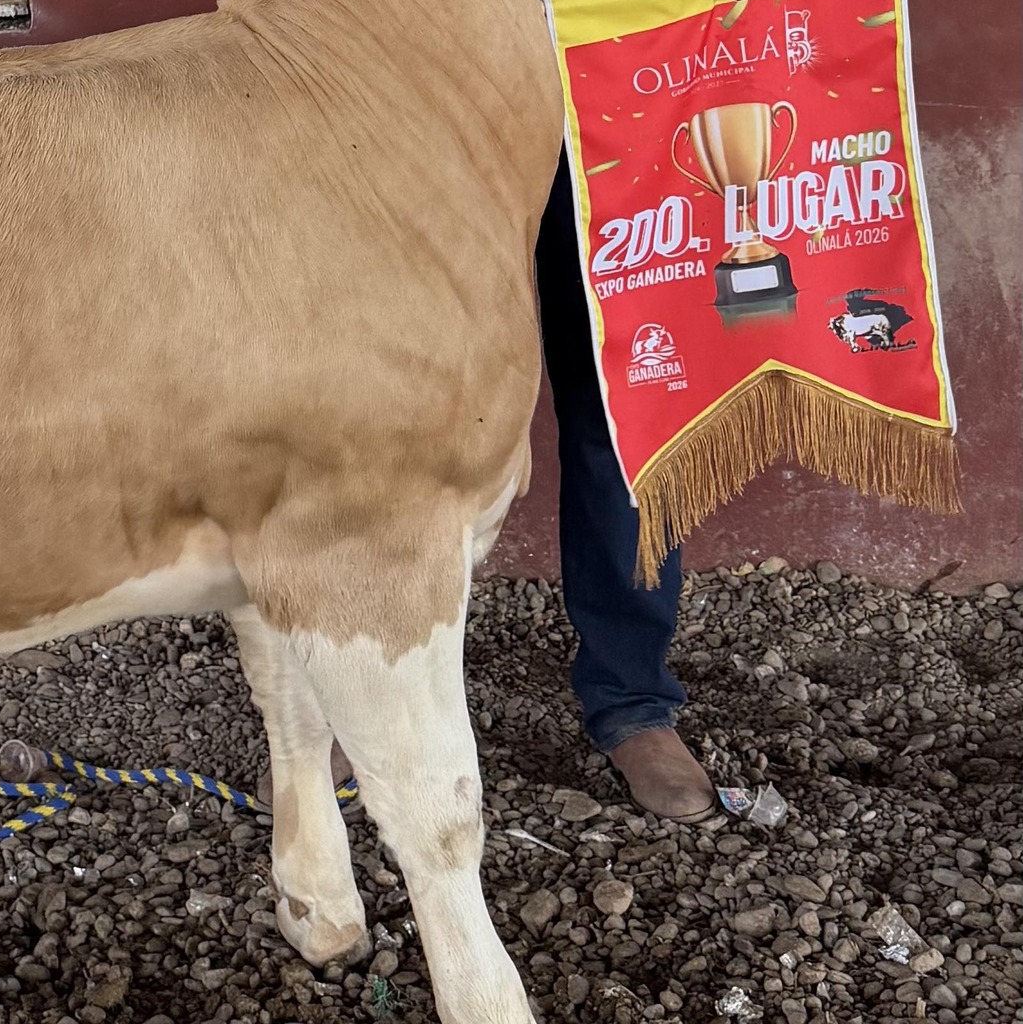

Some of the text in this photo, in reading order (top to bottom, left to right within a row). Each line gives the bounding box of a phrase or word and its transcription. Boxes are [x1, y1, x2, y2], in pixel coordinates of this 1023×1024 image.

[633, 26, 781, 94] OLINALÁ
[702, 65, 755, 80] MUNICIPAL
[811, 130, 891, 165] MACHO
[591, 160, 906, 276] 2DO. LUGAR
[806, 226, 889, 256] OLINALÁ 2026
[594, 259, 707, 301] EXPO GANADERA
[628, 361, 682, 383] GANADERA
[667, 379, 688, 392] 2026
